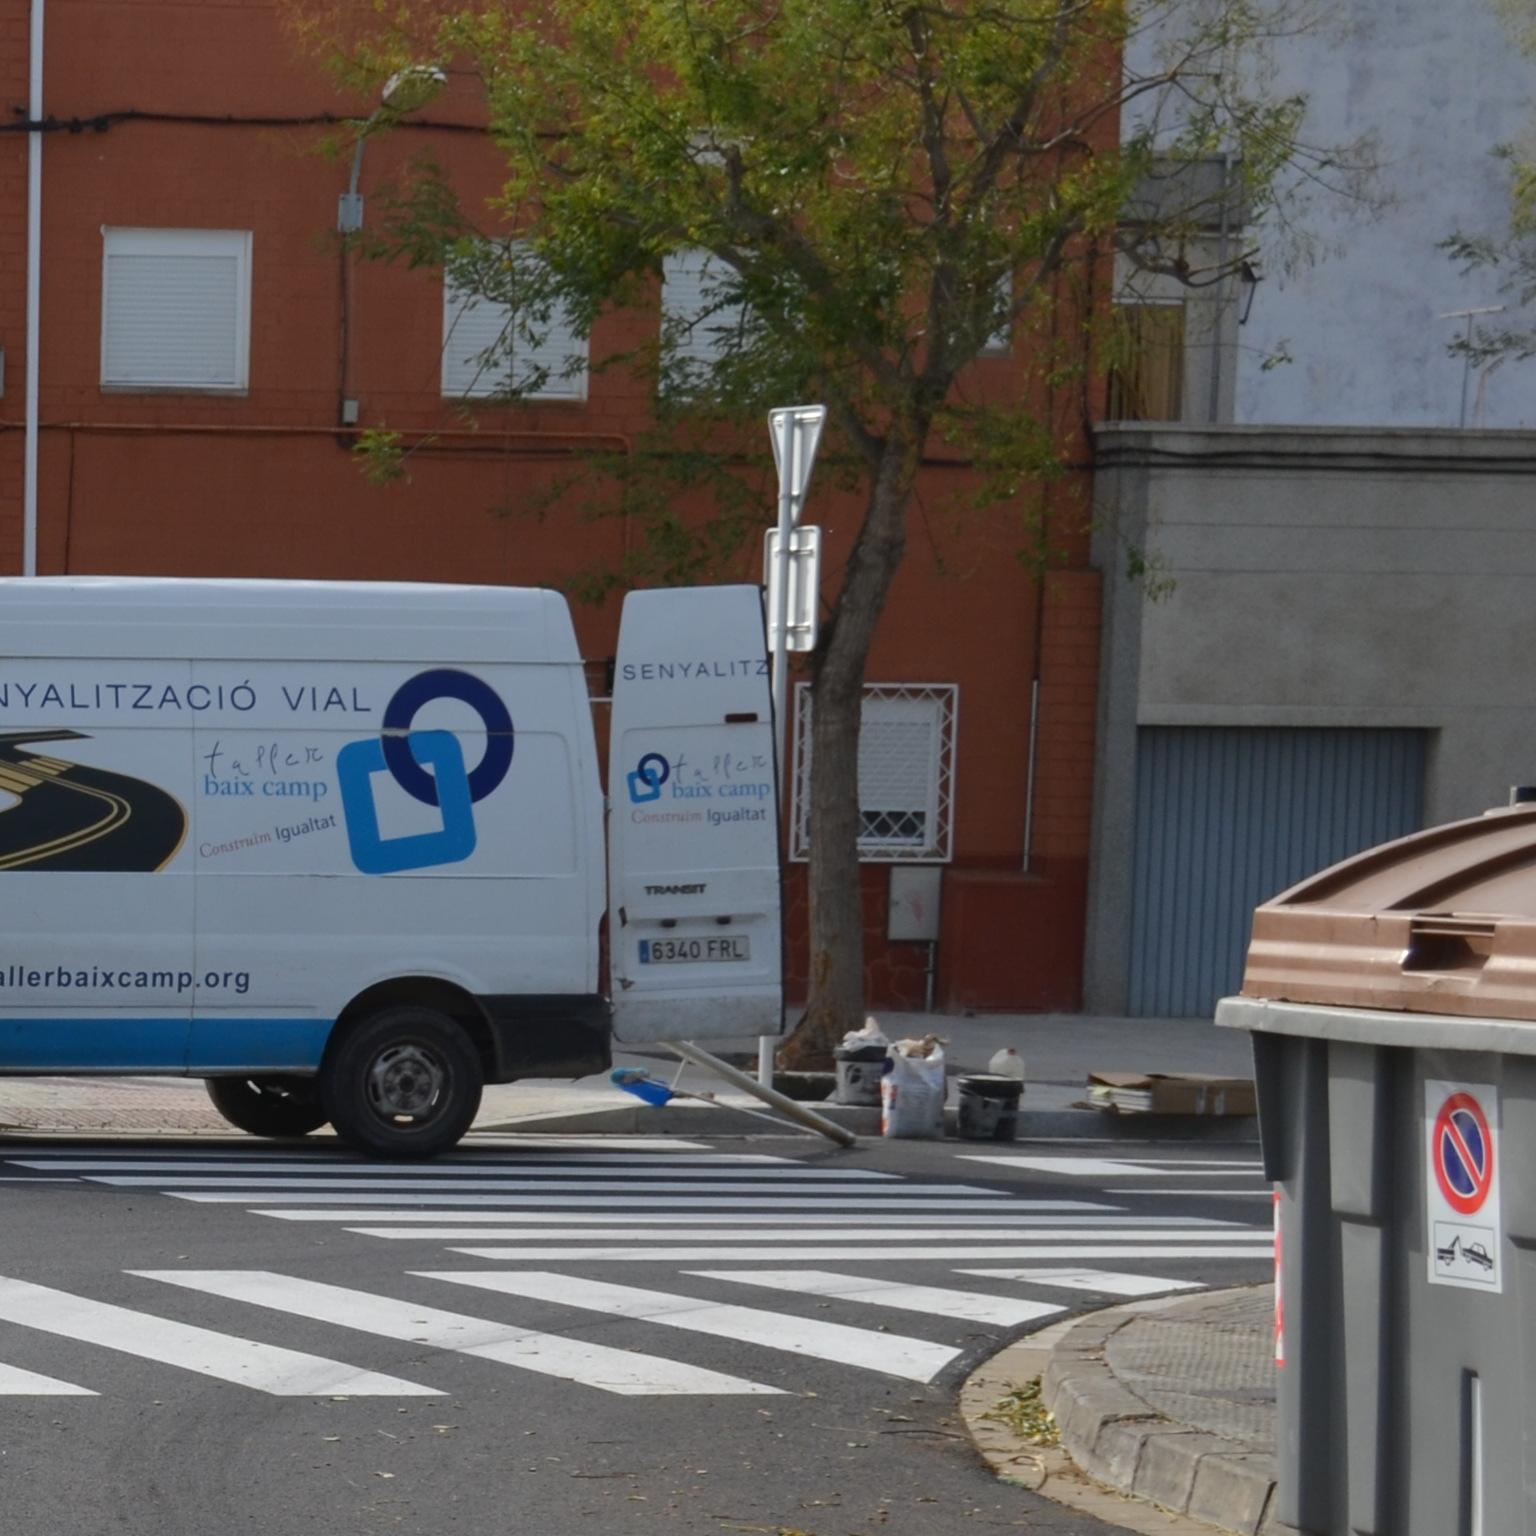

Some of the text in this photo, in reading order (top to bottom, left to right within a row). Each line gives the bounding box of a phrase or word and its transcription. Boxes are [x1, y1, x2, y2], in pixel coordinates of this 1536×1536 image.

[281, 686, 372, 712] VIAL
[203, 773, 328, 802] baix camp
[671, 781, 770, 801] baix camp
[631, 806, 767, 827] Construim Igualtat
[199, 813, 338, 858] Construim Igualtat
[644, 883, 707, 895] TRANSIT
[651, 939, 744, 960] 6340 FRL
